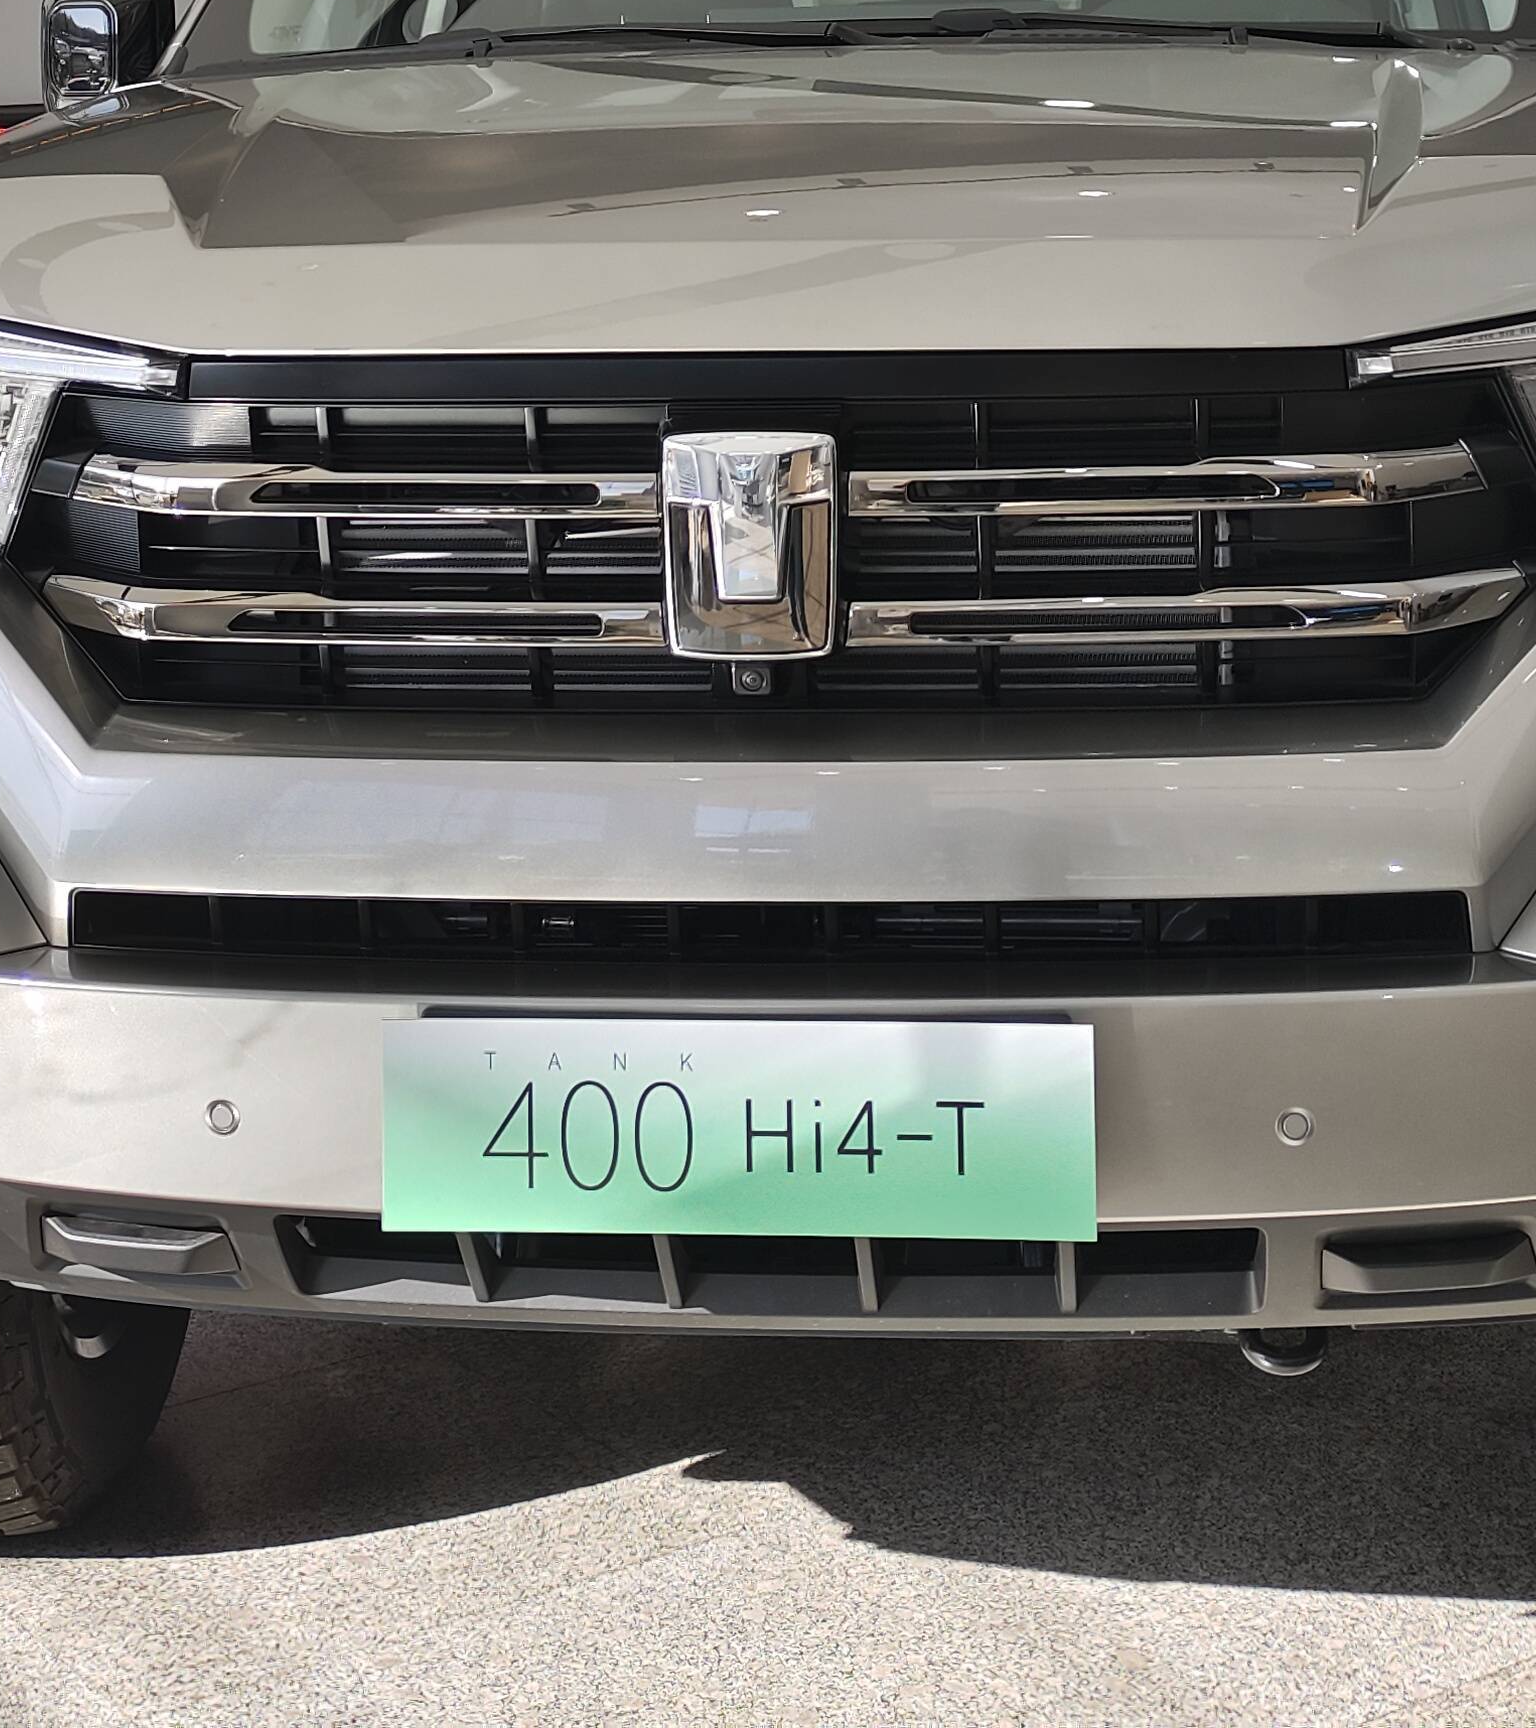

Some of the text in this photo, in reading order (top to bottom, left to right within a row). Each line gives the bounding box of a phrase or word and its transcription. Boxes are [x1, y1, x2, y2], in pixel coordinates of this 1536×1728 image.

[484, 1051, 693, 1072] TANK
[482, 1080, 986, 1193] 400 Hi4-T
